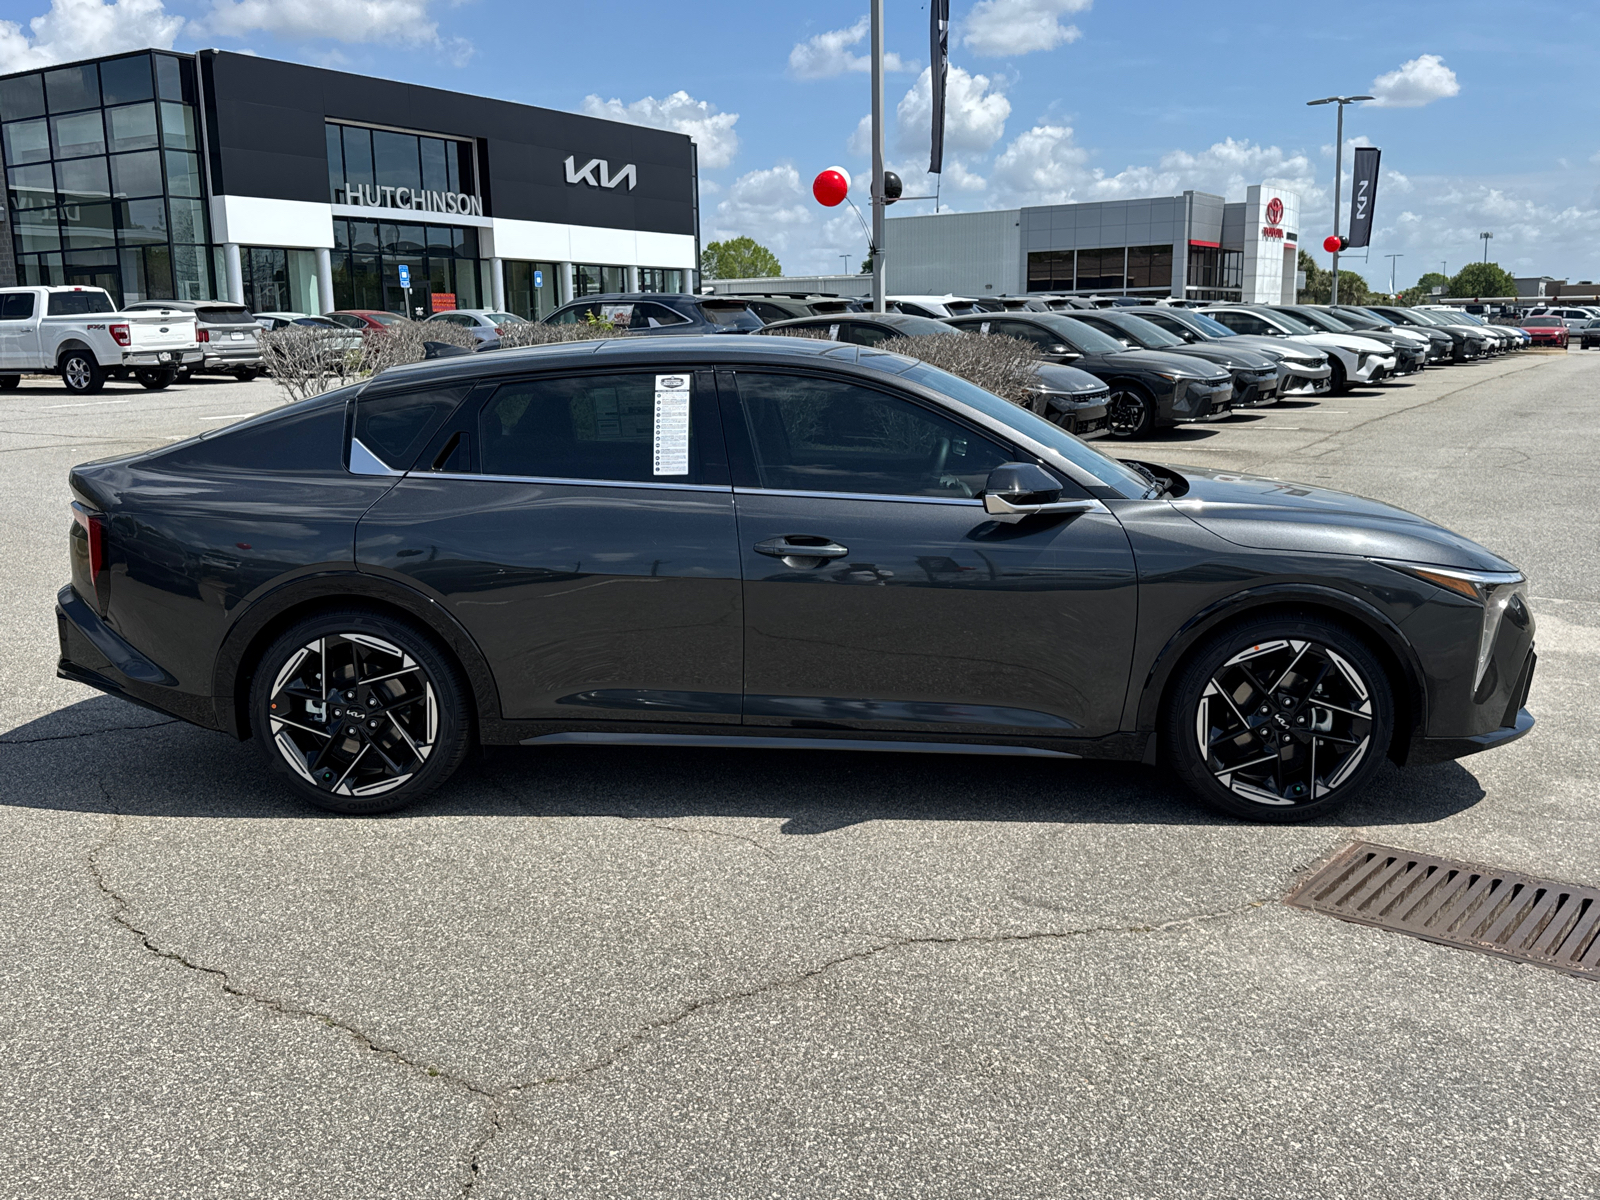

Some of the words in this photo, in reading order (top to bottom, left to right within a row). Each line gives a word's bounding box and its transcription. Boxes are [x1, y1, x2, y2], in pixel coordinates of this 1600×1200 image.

[564, 155, 636, 191] KIA
[345, 182, 483, 217] HUTCHINSON
[347, 795, 400, 810] KUMHO
[1265, 805, 1322, 820] KUMHO
